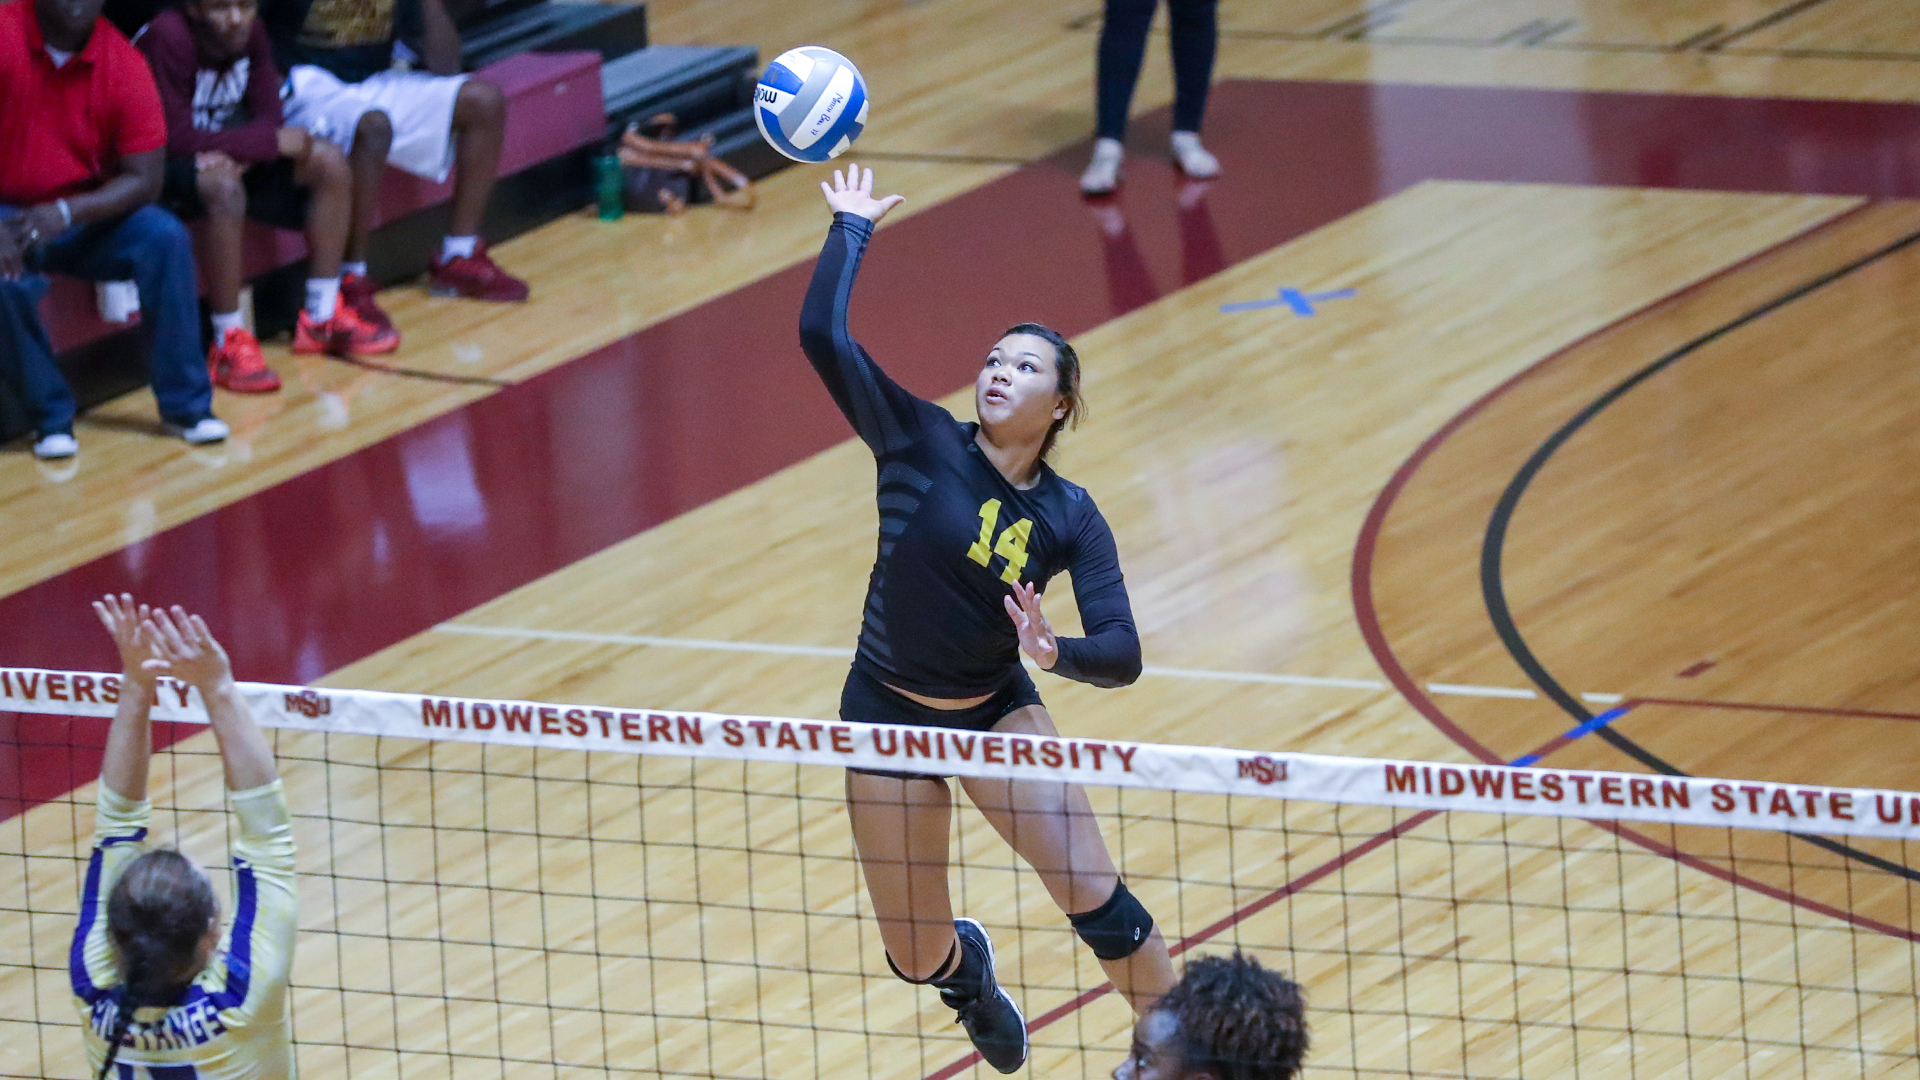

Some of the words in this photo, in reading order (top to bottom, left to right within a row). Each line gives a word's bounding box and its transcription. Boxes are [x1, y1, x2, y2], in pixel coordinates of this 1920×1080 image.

[966, 497, 1034, 586] 14
[285, 690, 331, 719] MSU
[422, 698, 704, 745] MIDWESTERN
[723, 718, 854, 754] STATE
[872, 727, 1138, 773] UNIVERSITY
[1236, 756, 1288, 785] MSU
[1384, 764, 1691, 809] MIDWESTERN
[1711, 784, 1855, 821] STATE
